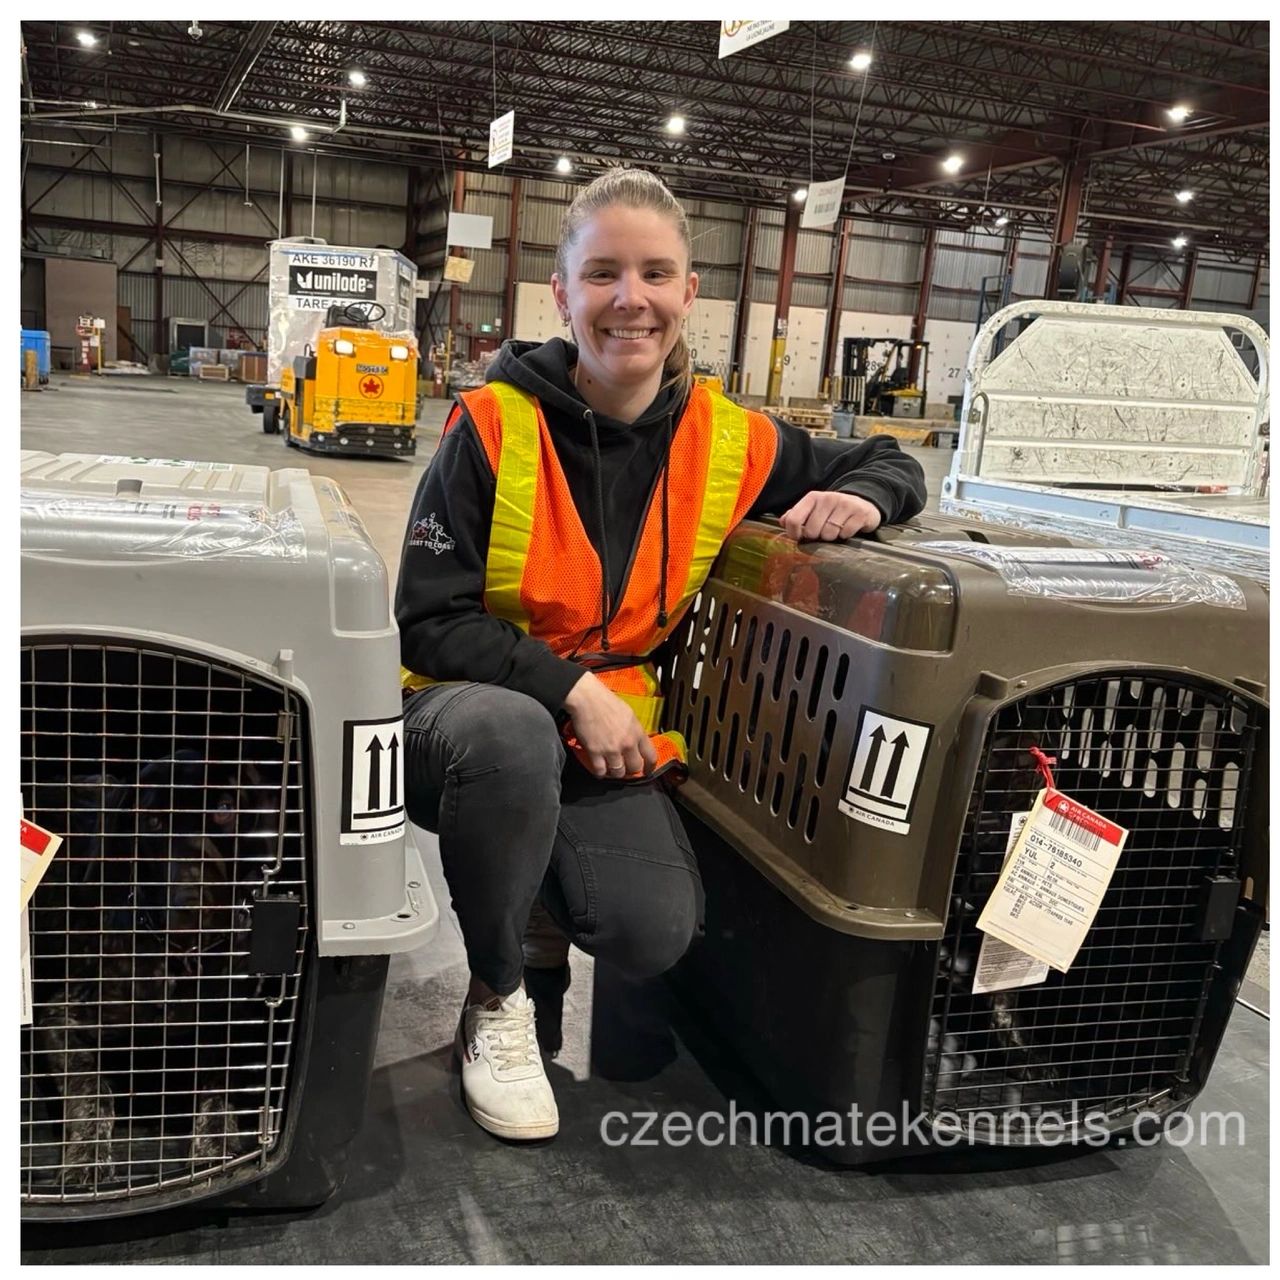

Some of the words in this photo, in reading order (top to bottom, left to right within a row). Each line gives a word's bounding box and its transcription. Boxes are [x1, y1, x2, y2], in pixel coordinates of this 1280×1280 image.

[292, 255, 318, 264] AKE
[322, 256, 356, 267] 36190
[359, 255, 375, 268] R7
[314, 273, 367, 292] unilode
[296, 297, 329, 309] TARE
[948, 368, 960, 378] 27
[867, 815, 894, 826] CANADA
[1070, 806, 1083, 816] AIR
[1081, 812, 1108, 829] CANADA
[1023, 847, 1040, 861] YUL
[1049, 861, 1056, 870] 2
